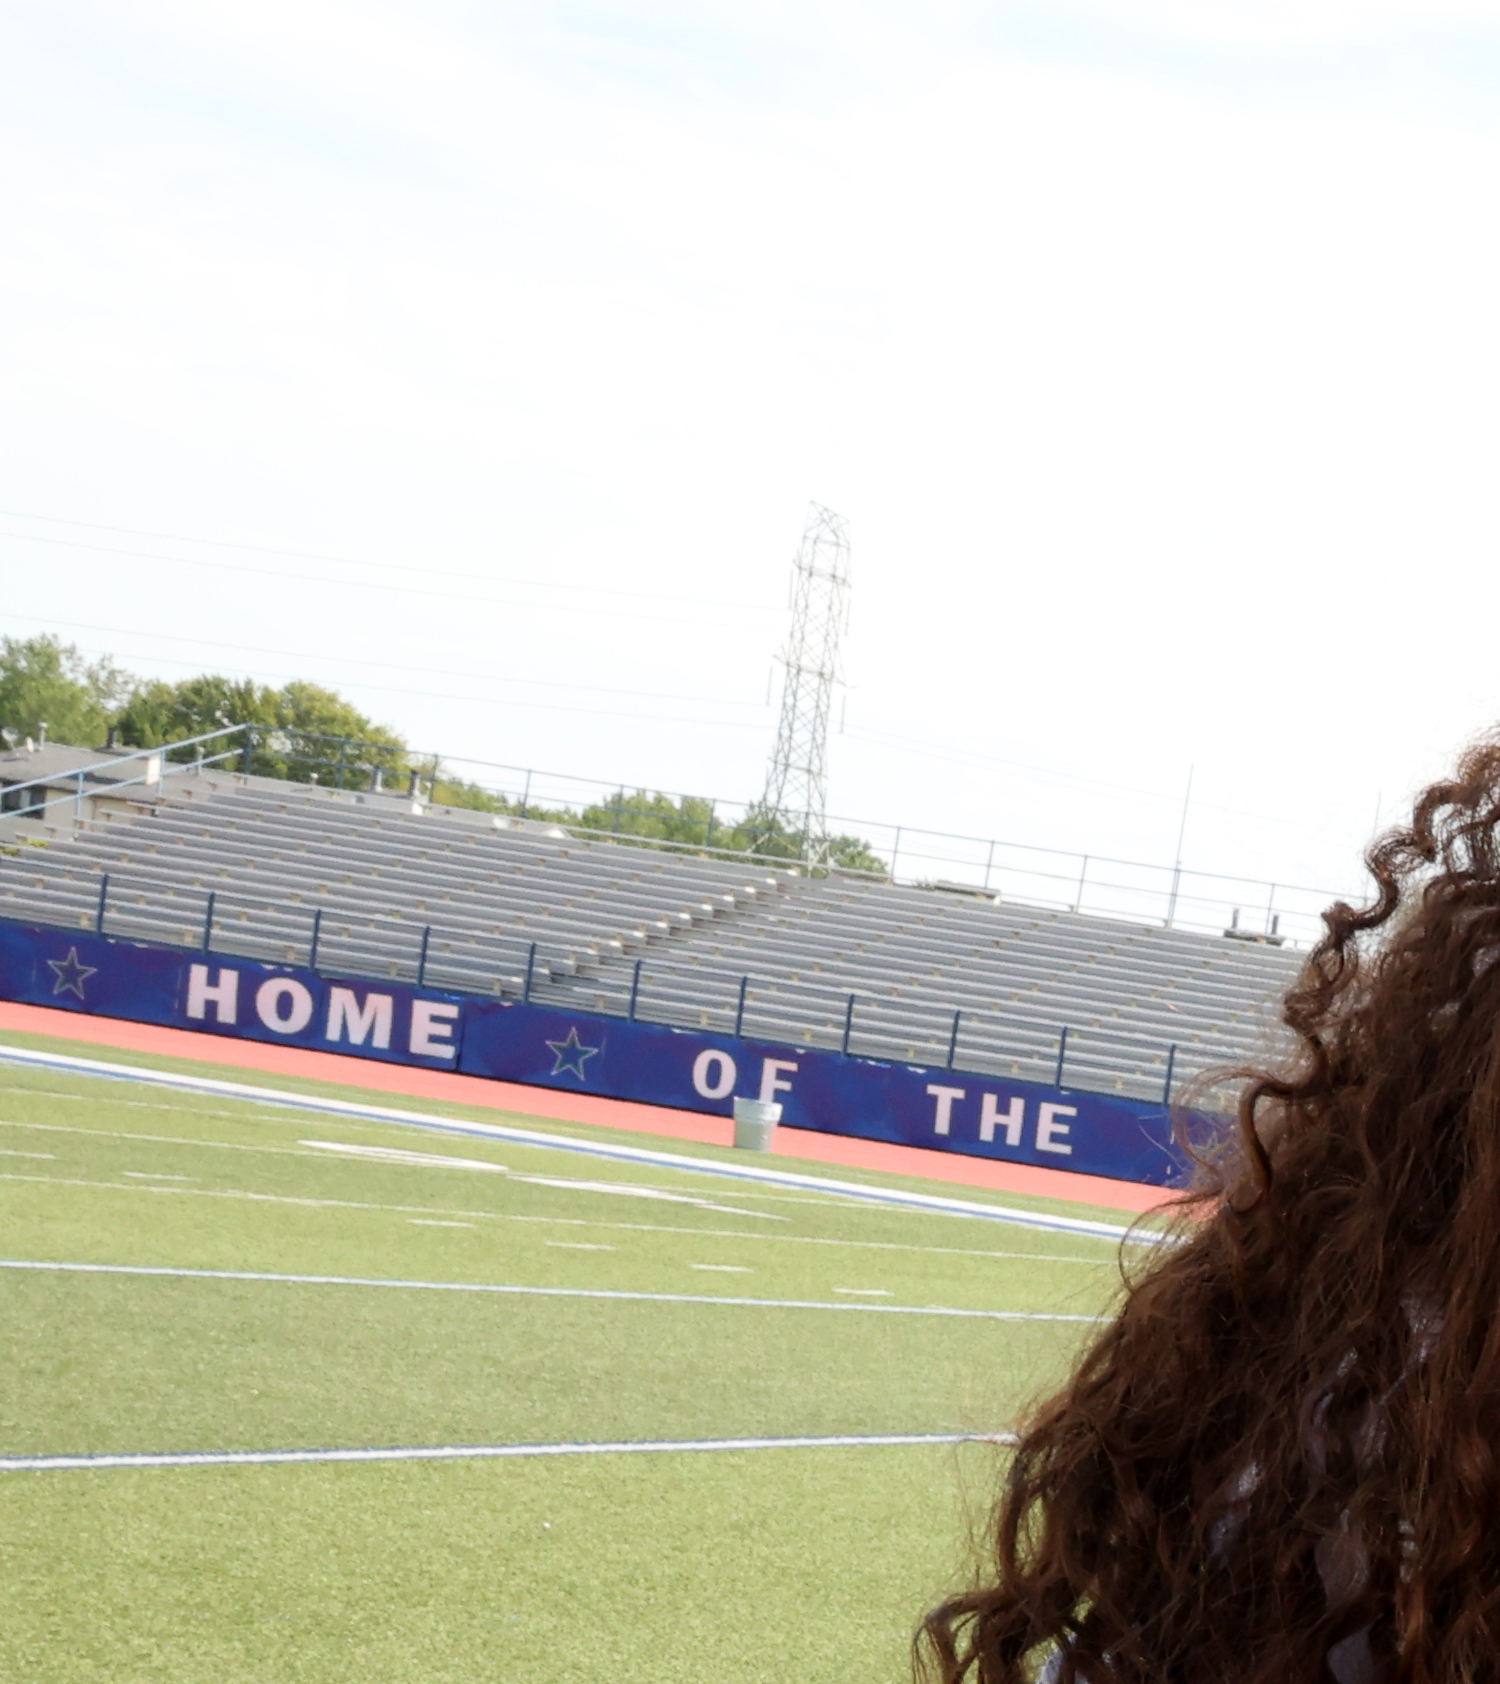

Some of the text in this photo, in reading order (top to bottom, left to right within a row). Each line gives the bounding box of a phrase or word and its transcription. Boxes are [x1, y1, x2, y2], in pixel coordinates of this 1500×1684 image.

[186, 963, 1078, 1156] HOME OF THE
